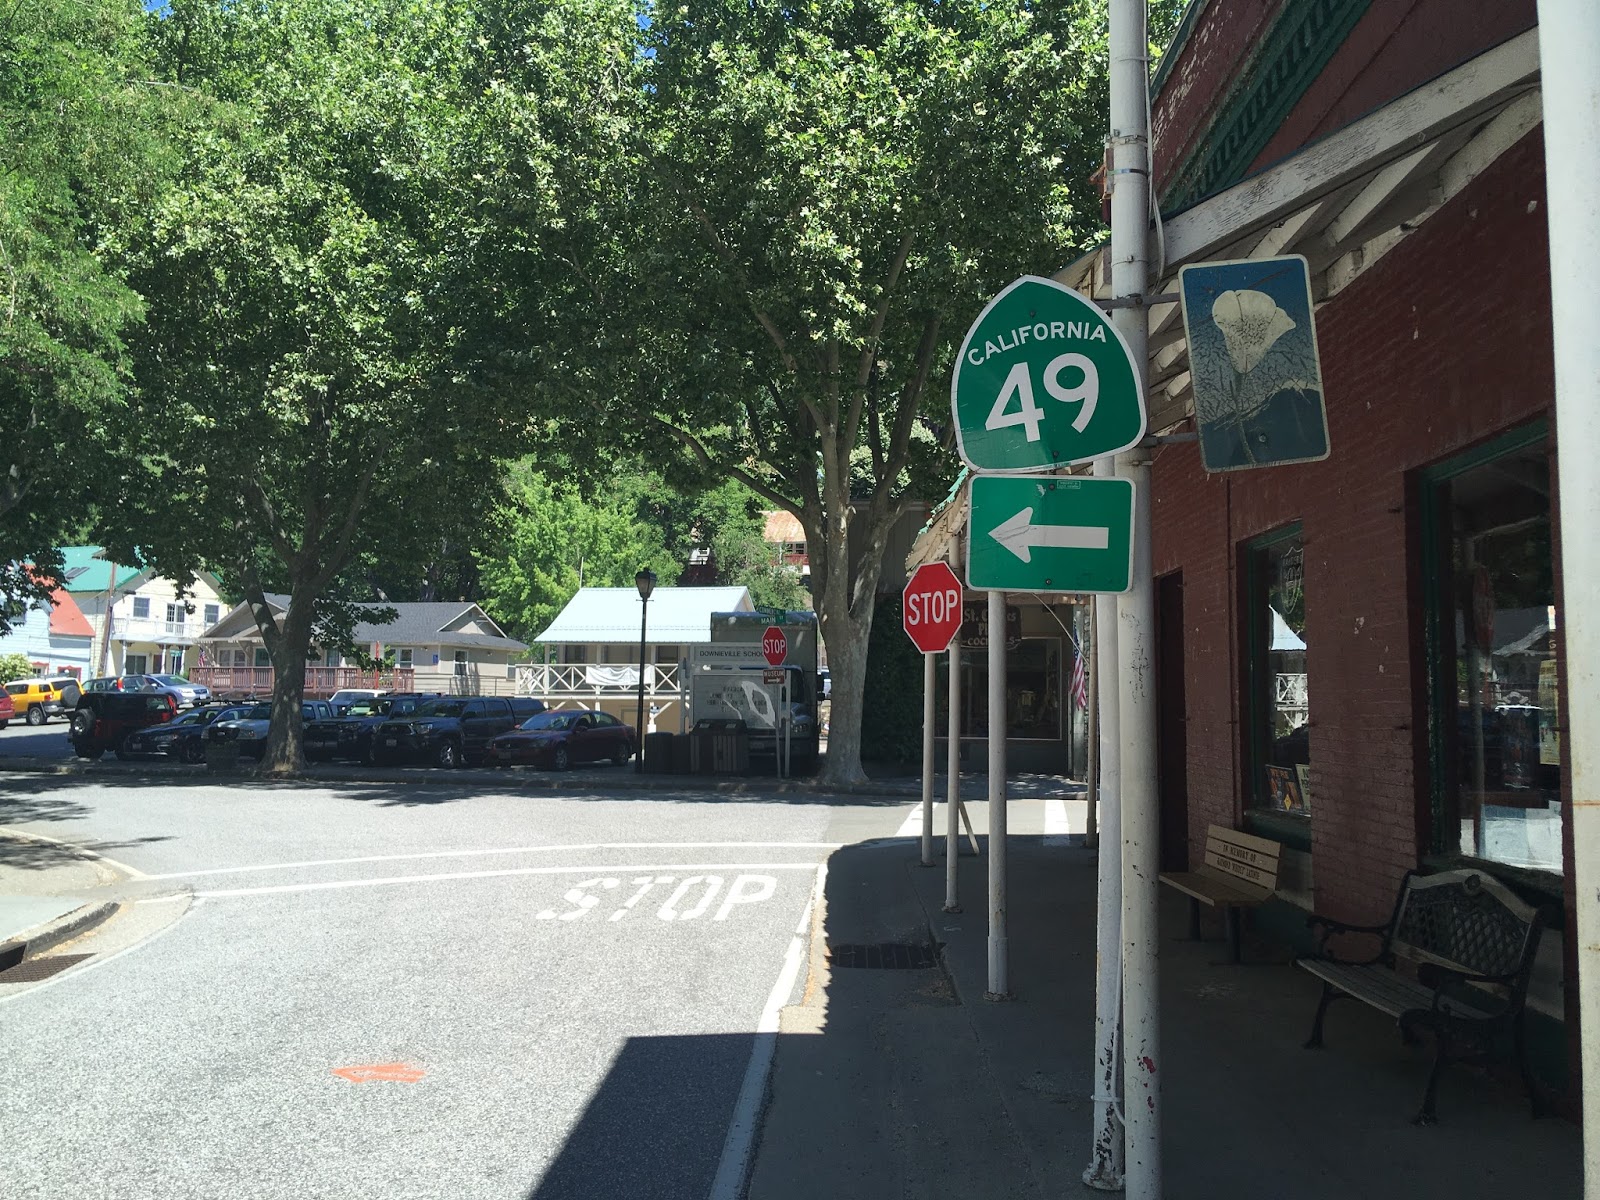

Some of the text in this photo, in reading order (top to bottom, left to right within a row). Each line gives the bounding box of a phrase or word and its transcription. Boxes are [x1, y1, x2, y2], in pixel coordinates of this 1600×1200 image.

[968, 321, 1107, 366] CALIFORNIA
[985, 352, 1099, 443] 49
[761, 616, 776, 624] MAIN
[908, 589, 958, 626] STOP
[764, 639, 786, 654] STOP
[1230, 847, 1249, 859] MEMORY
[535, 874, 778, 921] STOP
